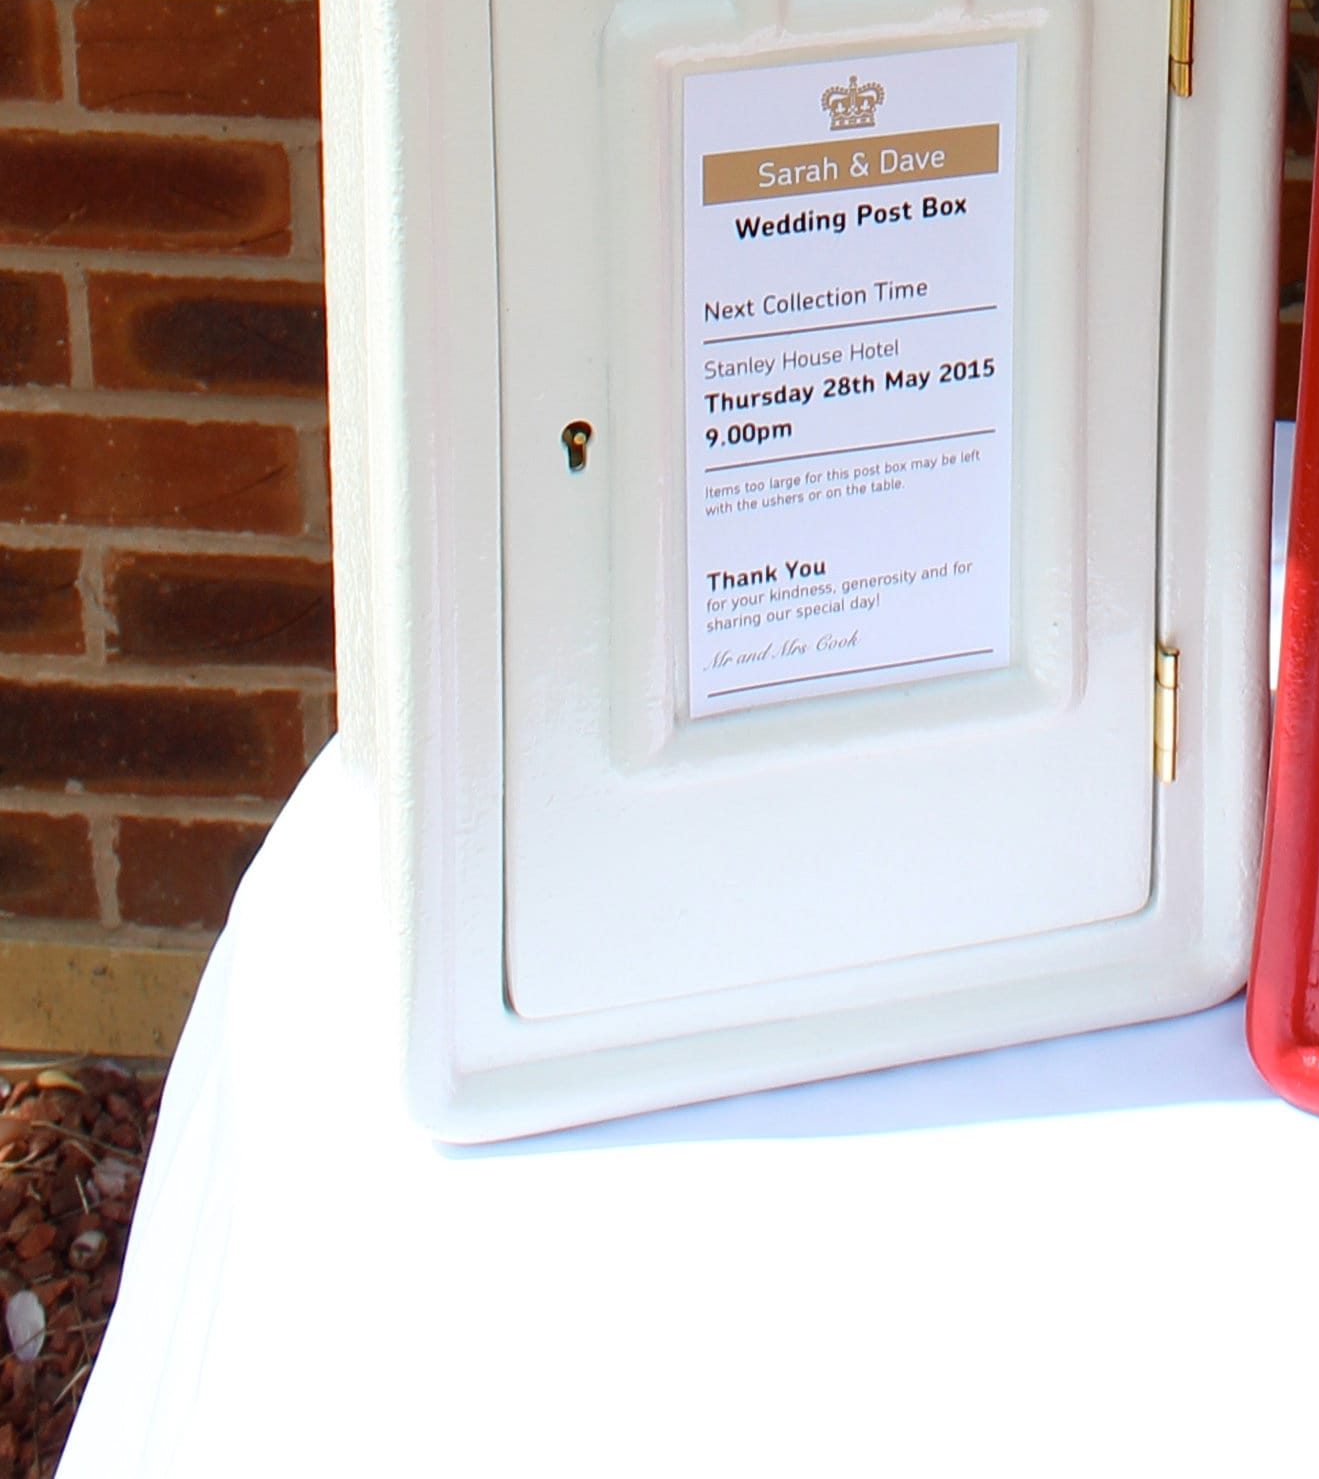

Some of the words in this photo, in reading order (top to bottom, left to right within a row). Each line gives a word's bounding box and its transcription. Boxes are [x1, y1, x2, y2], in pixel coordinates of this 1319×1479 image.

[758, 158, 838, 188] Sarah
[850, 152, 869, 177] &
[880, 148, 946, 175] Dave
[735, 209, 846, 240] Wedding
[857, 200, 912, 226] Post
[922, 196, 967, 218] Box
[705, 299, 754, 322] Next
[763, 287, 867, 315] Collection
[874, 279, 928, 302] Time
[704, 357, 775, 380] Stanley
[783, 347, 842, 369] House
[850, 339, 899, 360] Hotel
[705, 383, 814, 414] Thursday
[823, 375, 875, 399] 28th
[886, 369, 930, 391] May
[939, 359, 995, 384] 2015
[705, 421, 792, 448] 9.00pm
[705, 483, 740, 500] Items
[745, 480, 765, 493] too
[770, 475, 801, 491] large
[805, 472, 822, 484] for
[826, 468, 849, 482] this
[854, 464, 880, 480] post
[884, 461, 906, 474] box
[911, 456, 937, 471] may
[941, 453, 957, 466] be
[960, 449, 981, 464] left
[705, 502, 732, 517] with
[737, 497, 757, 511] the
[762, 492, 804, 508] ushers
[808, 489, 820, 501] or
[826, 486, 842, 498] on
[846, 482, 867, 497] the
[871, 478, 905, 492] table.
[707, 599, 727, 612] for
[731, 592, 764, 610] your
[770, 581, 837, 602] kindness,
[842, 571, 916, 593] generosity
[921, 565, 948, 581] and
[953, 561, 974, 576] for
[708, 565, 778, 592] Thank
[785, 560, 826, 579] You
[707, 612, 761, 633] sharing
[766, 608, 791, 622] our
[796, 599, 845, 618] special
[850, 593, 881, 612] day!
[704, 652, 732, 671] Mr
[737, 644, 770, 665] and
[772, 640, 807, 659] Mrs
[816, 630, 860, 651] Cook
